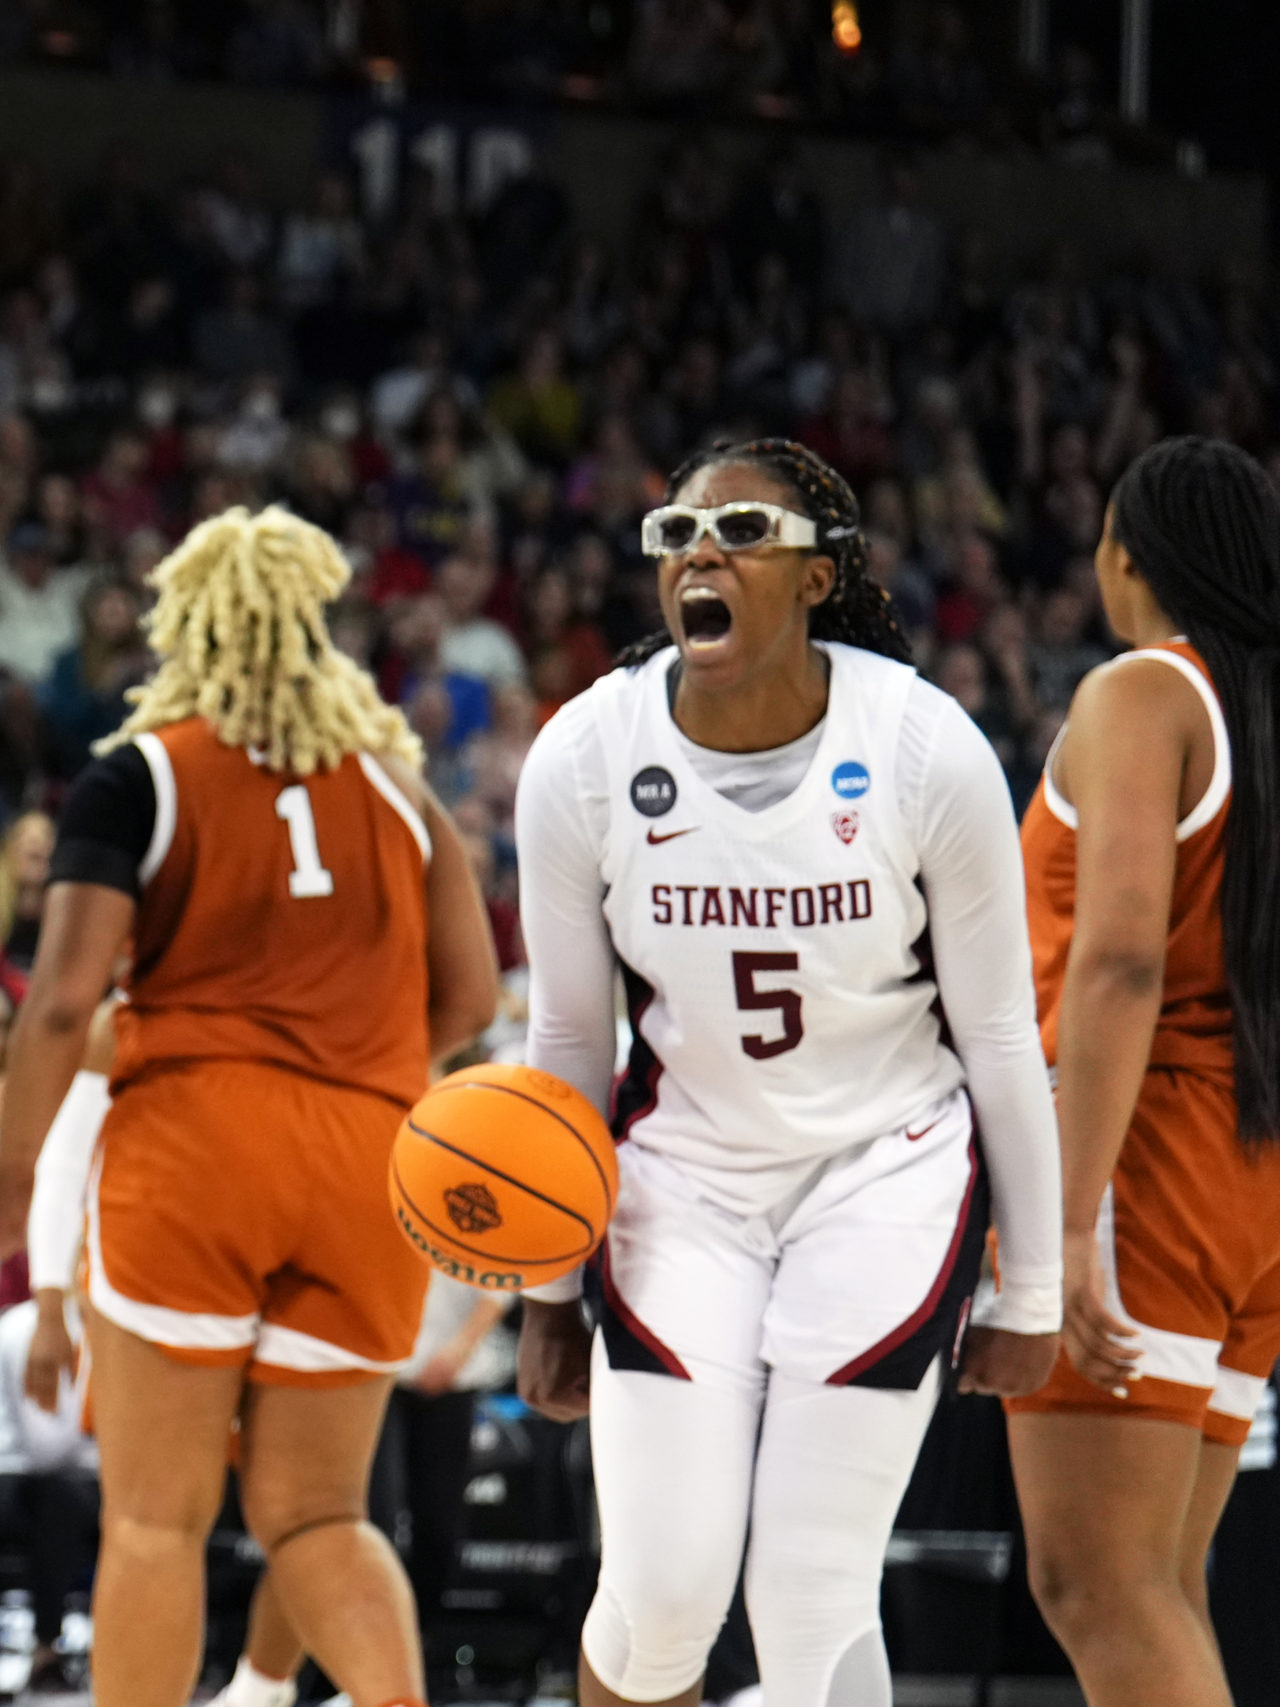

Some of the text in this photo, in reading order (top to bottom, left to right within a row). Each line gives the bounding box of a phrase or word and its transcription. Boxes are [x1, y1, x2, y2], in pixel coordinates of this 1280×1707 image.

[274, 784, 334, 898] 1
[651, 879, 872, 928] STANFORD
[732, 950, 804, 1060] 5
